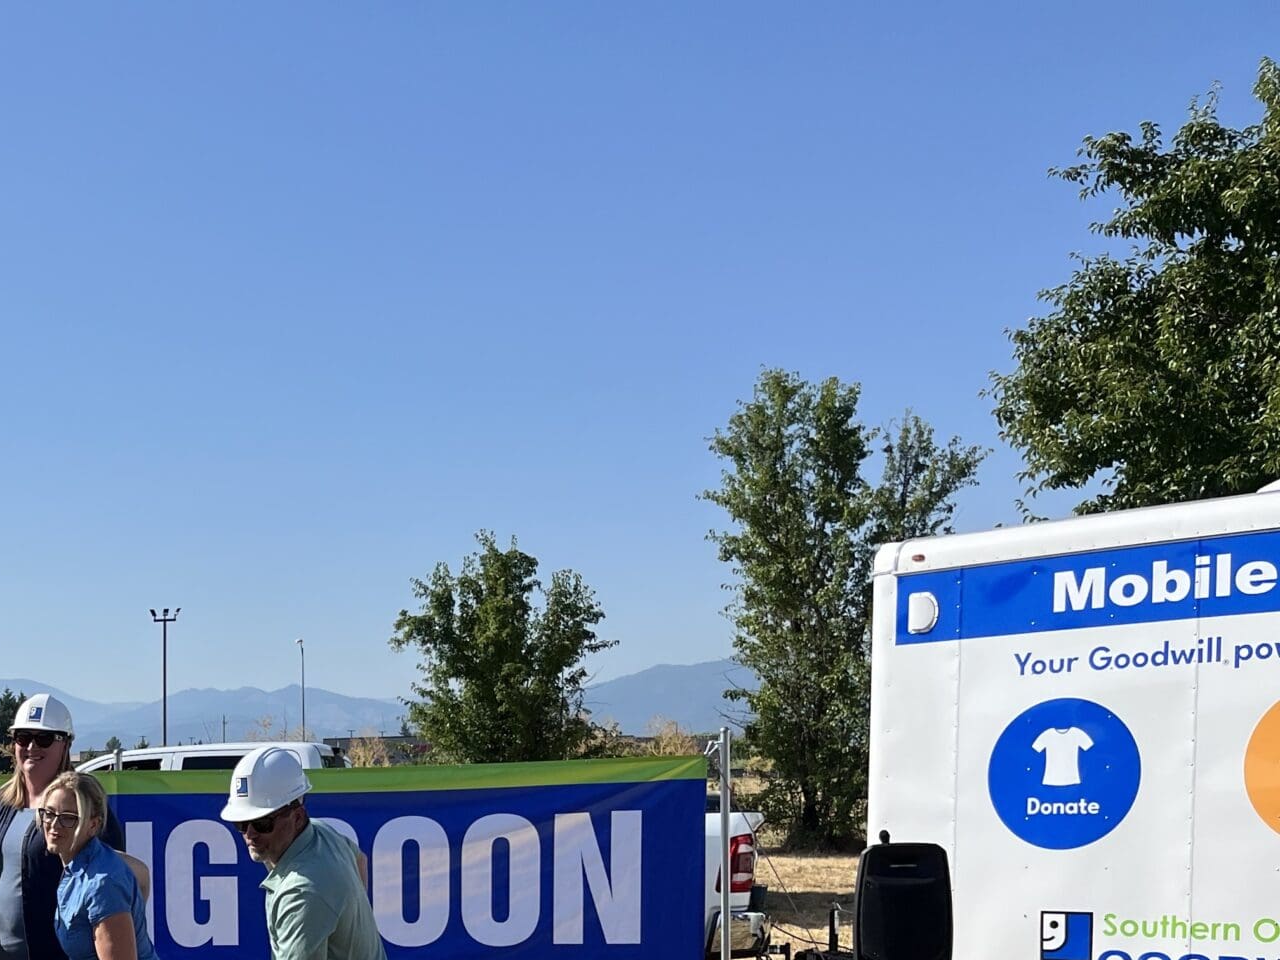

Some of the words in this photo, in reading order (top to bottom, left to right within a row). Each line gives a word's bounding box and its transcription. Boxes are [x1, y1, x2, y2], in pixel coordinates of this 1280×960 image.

[1052, 552, 1279, 614] Mobile
[1014, 652, 1079, 676] Your
[1088, 636, 1223, 671] Goodwill
[1026, 797, 1100, 816] Donate
[1103, 913, 1241, 941] Southern
